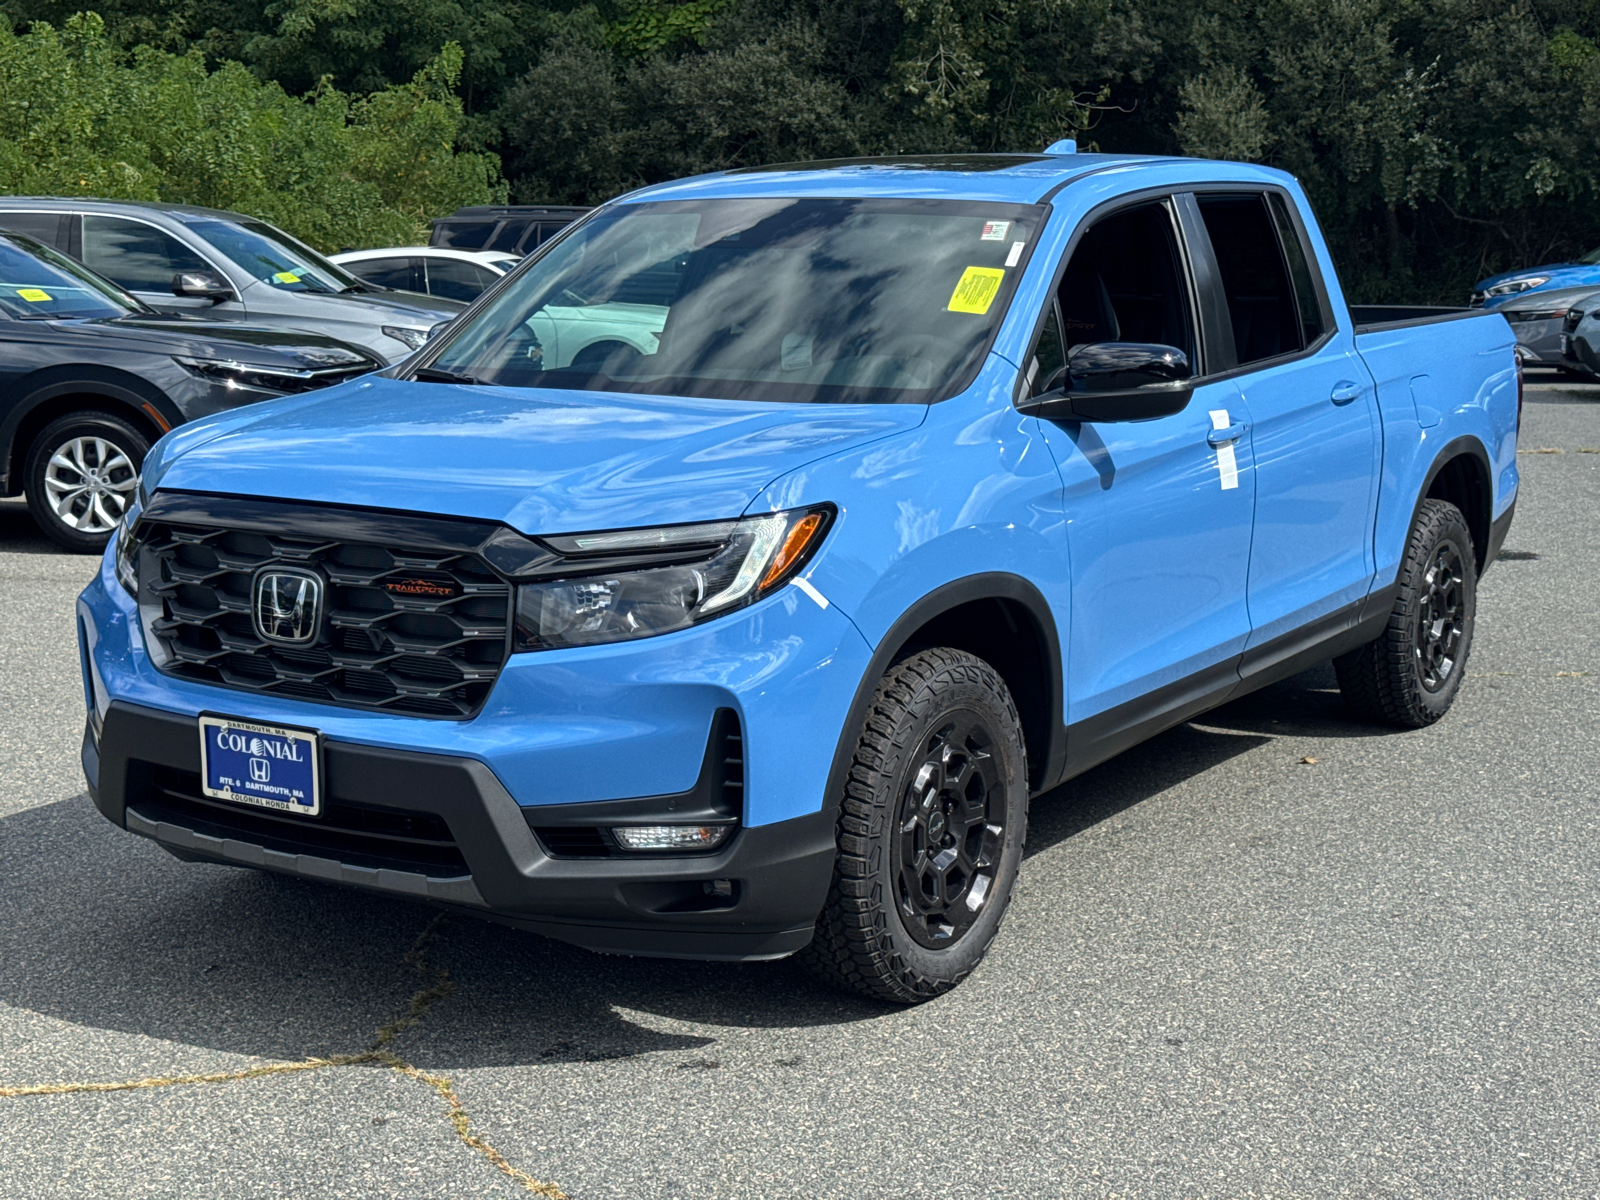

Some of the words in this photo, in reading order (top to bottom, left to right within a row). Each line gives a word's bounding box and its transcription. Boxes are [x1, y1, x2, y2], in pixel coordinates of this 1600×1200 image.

[386, 583, 452, 595] TRAILSPORT
[217, 732, 303, 762] COLONIAL
[219, 776, 235, 786] RTE.
[236, 779, 241, 787] 6
[245, 781, 292, 797] DARTMOUTH,
[292, 789, 304, 798] MA
[231, 793, 264, 805] COLONIAL
[265, 798, 290, 810] HONDA
